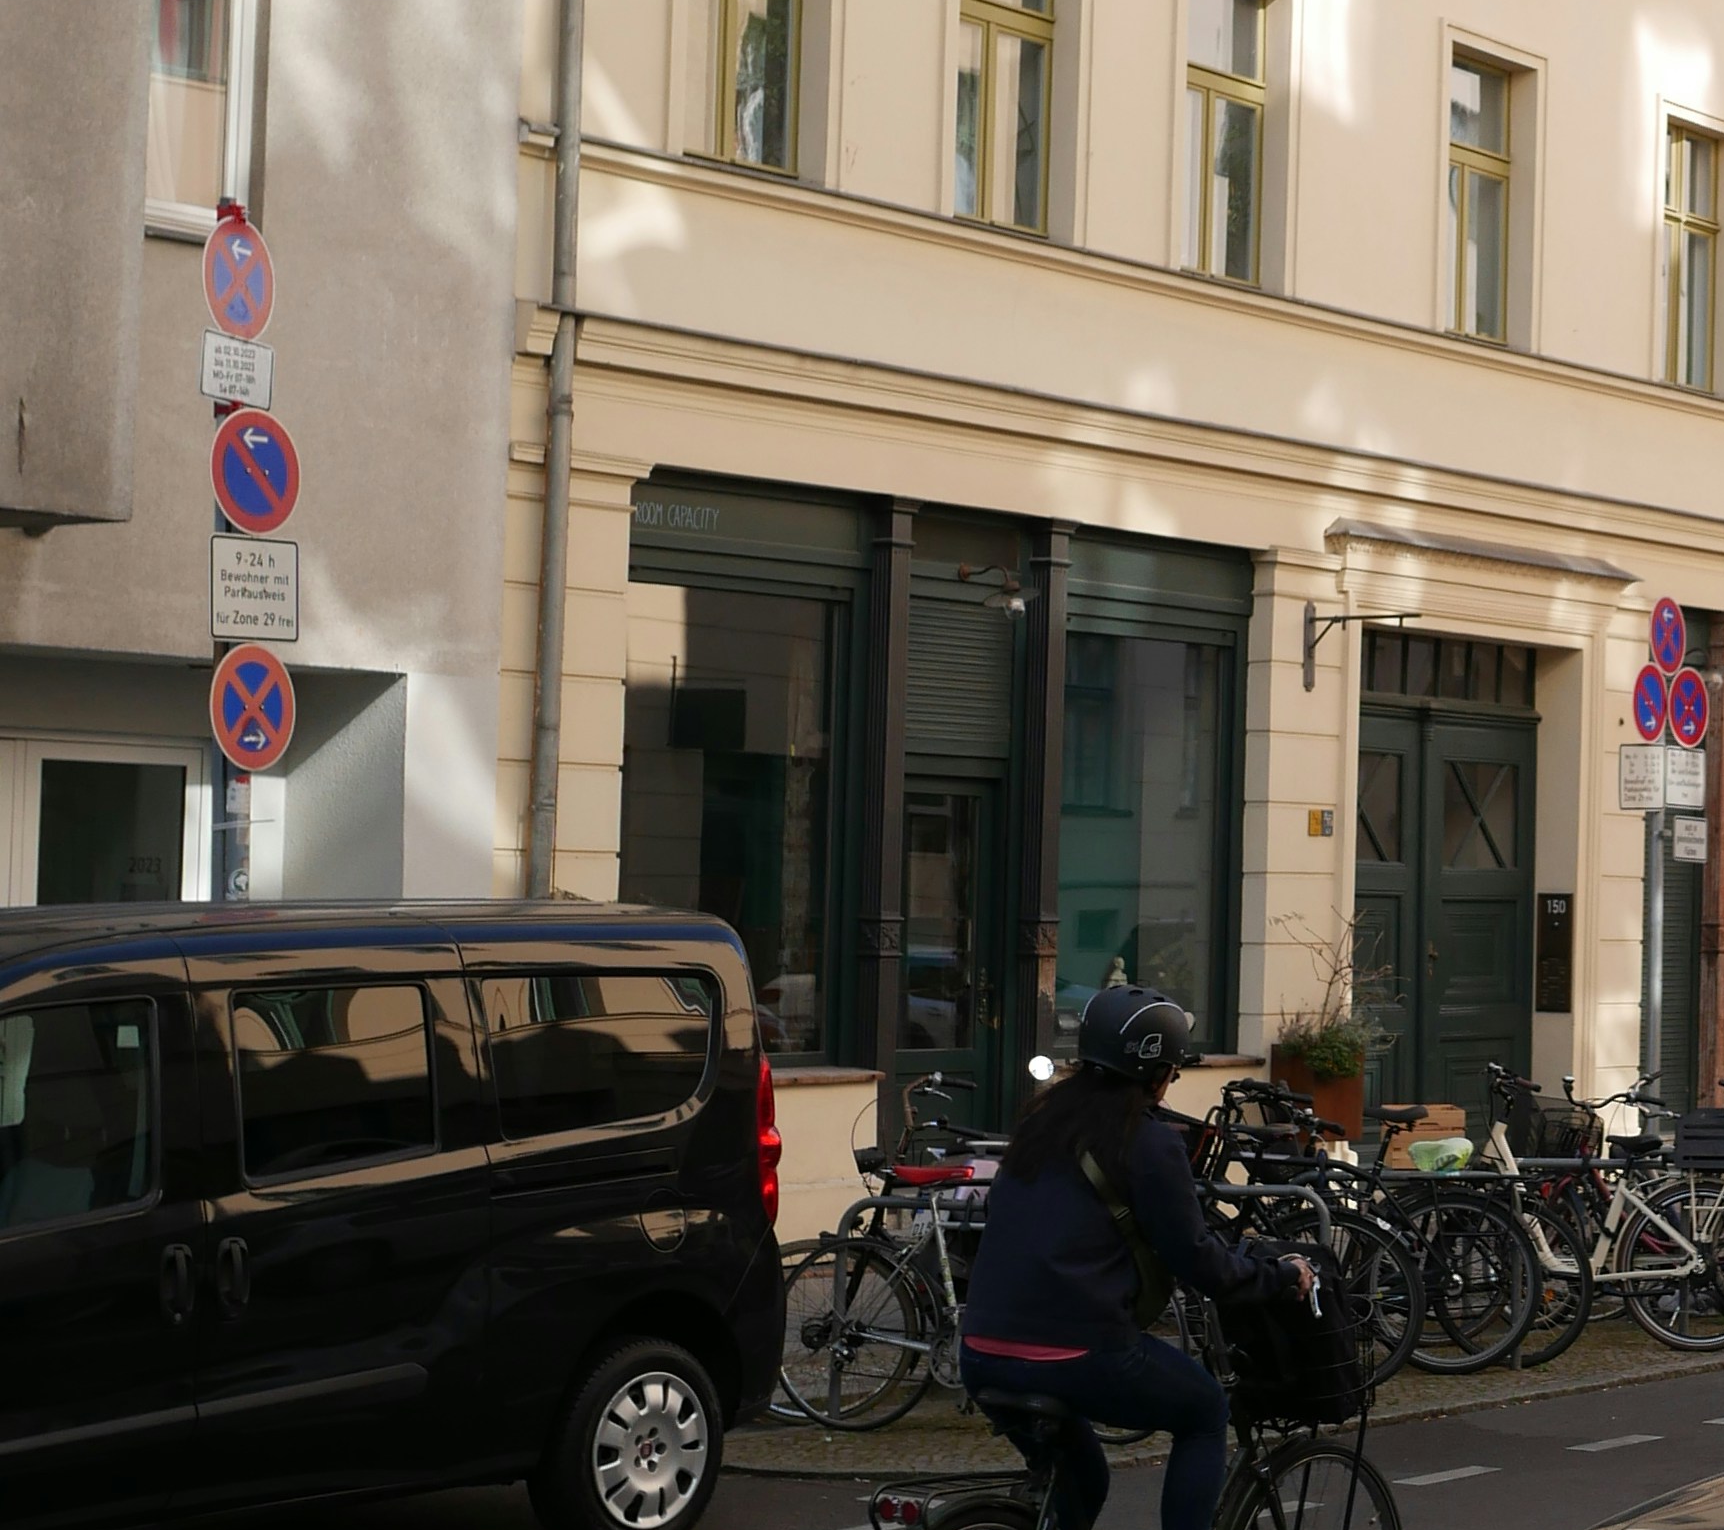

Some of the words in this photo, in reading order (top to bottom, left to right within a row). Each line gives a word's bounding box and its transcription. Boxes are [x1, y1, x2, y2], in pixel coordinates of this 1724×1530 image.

[635, 501, 663, 526] ROOM
[667, 504, 720, 531] CAPACITY
[268, 554, 275, 568] h
[220, 569, 269, 585] Bewohner
[274, 575, 289, 586] mit
[224, 586, 286, 602] Parkausweis
[216, 612, 230, 624] für
[233, 610, 259, 626] Zone
[263, 612, 276, 626] 29
[278, 615, 294, 628] frei
[128, 856, 162, 873] 2023
[1547, 899, 1566, 914] 150
